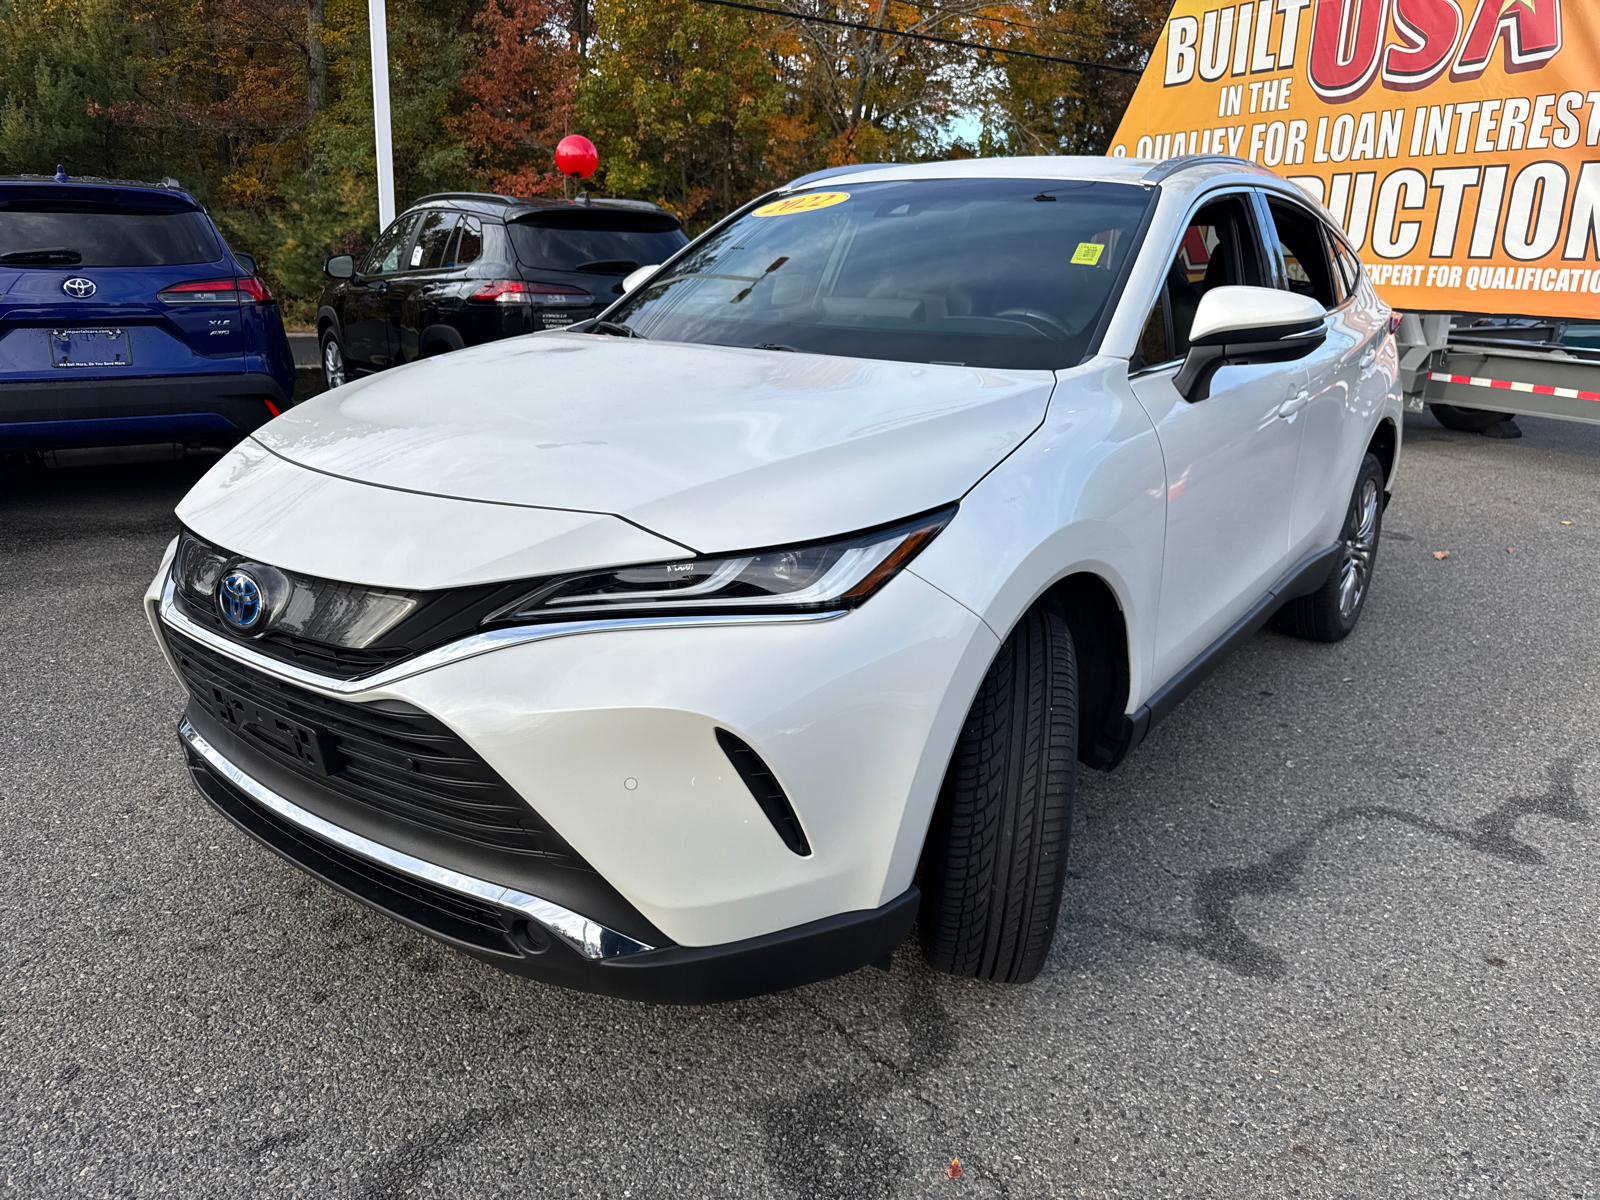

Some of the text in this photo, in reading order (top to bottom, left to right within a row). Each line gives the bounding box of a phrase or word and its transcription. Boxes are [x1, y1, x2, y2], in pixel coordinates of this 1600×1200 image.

[1163, 0, 1311, 88] BUILT
[1217, 77, 1293, 118] IN THE
[1249, 119, 1308, 167] FOR
[1312, 108, 1405, 163] LOAN
[1408, 90, 1600, 157] INTEREST
[762, 194, 837, 214] 2022
[1287, 160, 1600, 262] UCTION
[1426, 265, 1463, 288] FOR
[209, 319, 230, 327] XLE
